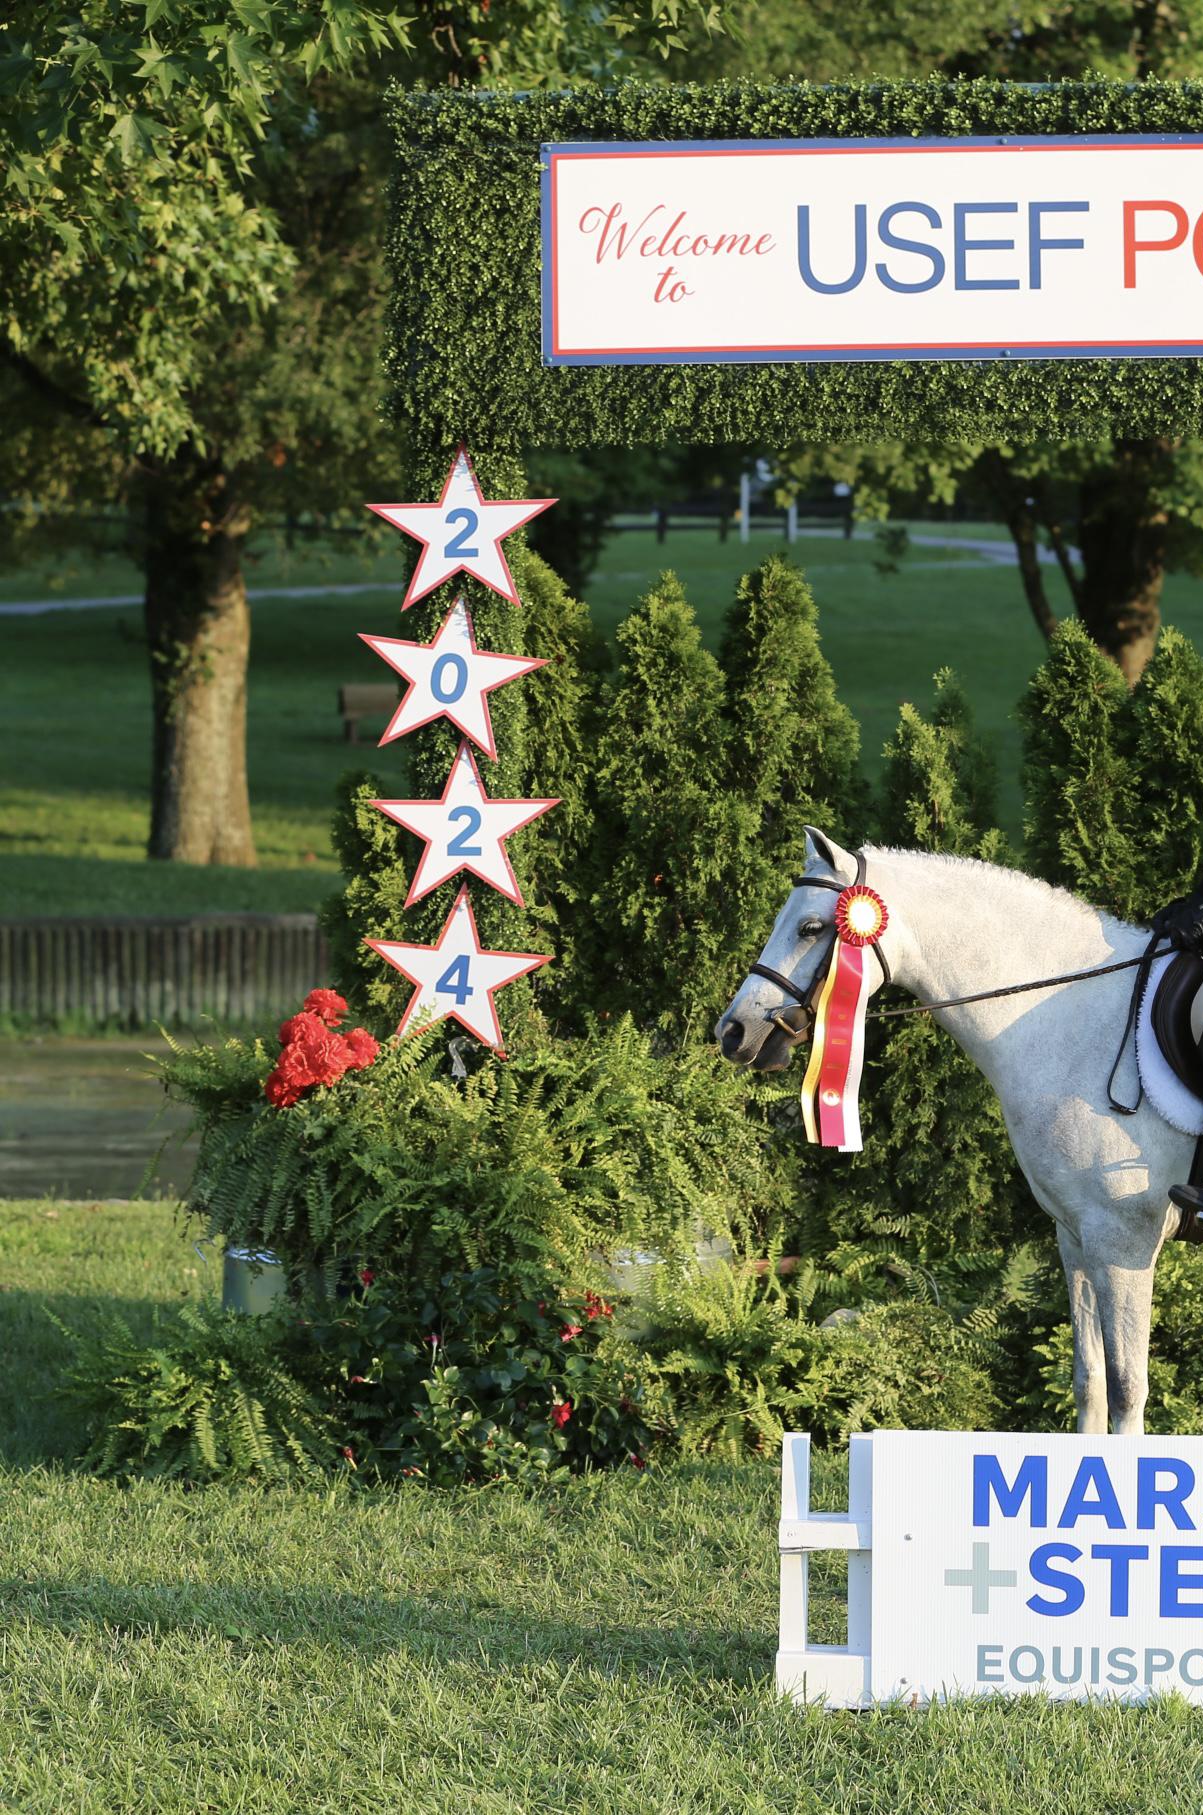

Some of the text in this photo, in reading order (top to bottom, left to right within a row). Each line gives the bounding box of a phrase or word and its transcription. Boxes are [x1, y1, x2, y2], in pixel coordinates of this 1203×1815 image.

[578, 202, 777, 266] Welcome
[796, 201, 1090, 294] USEF
[653, 264, 695, 304] to
